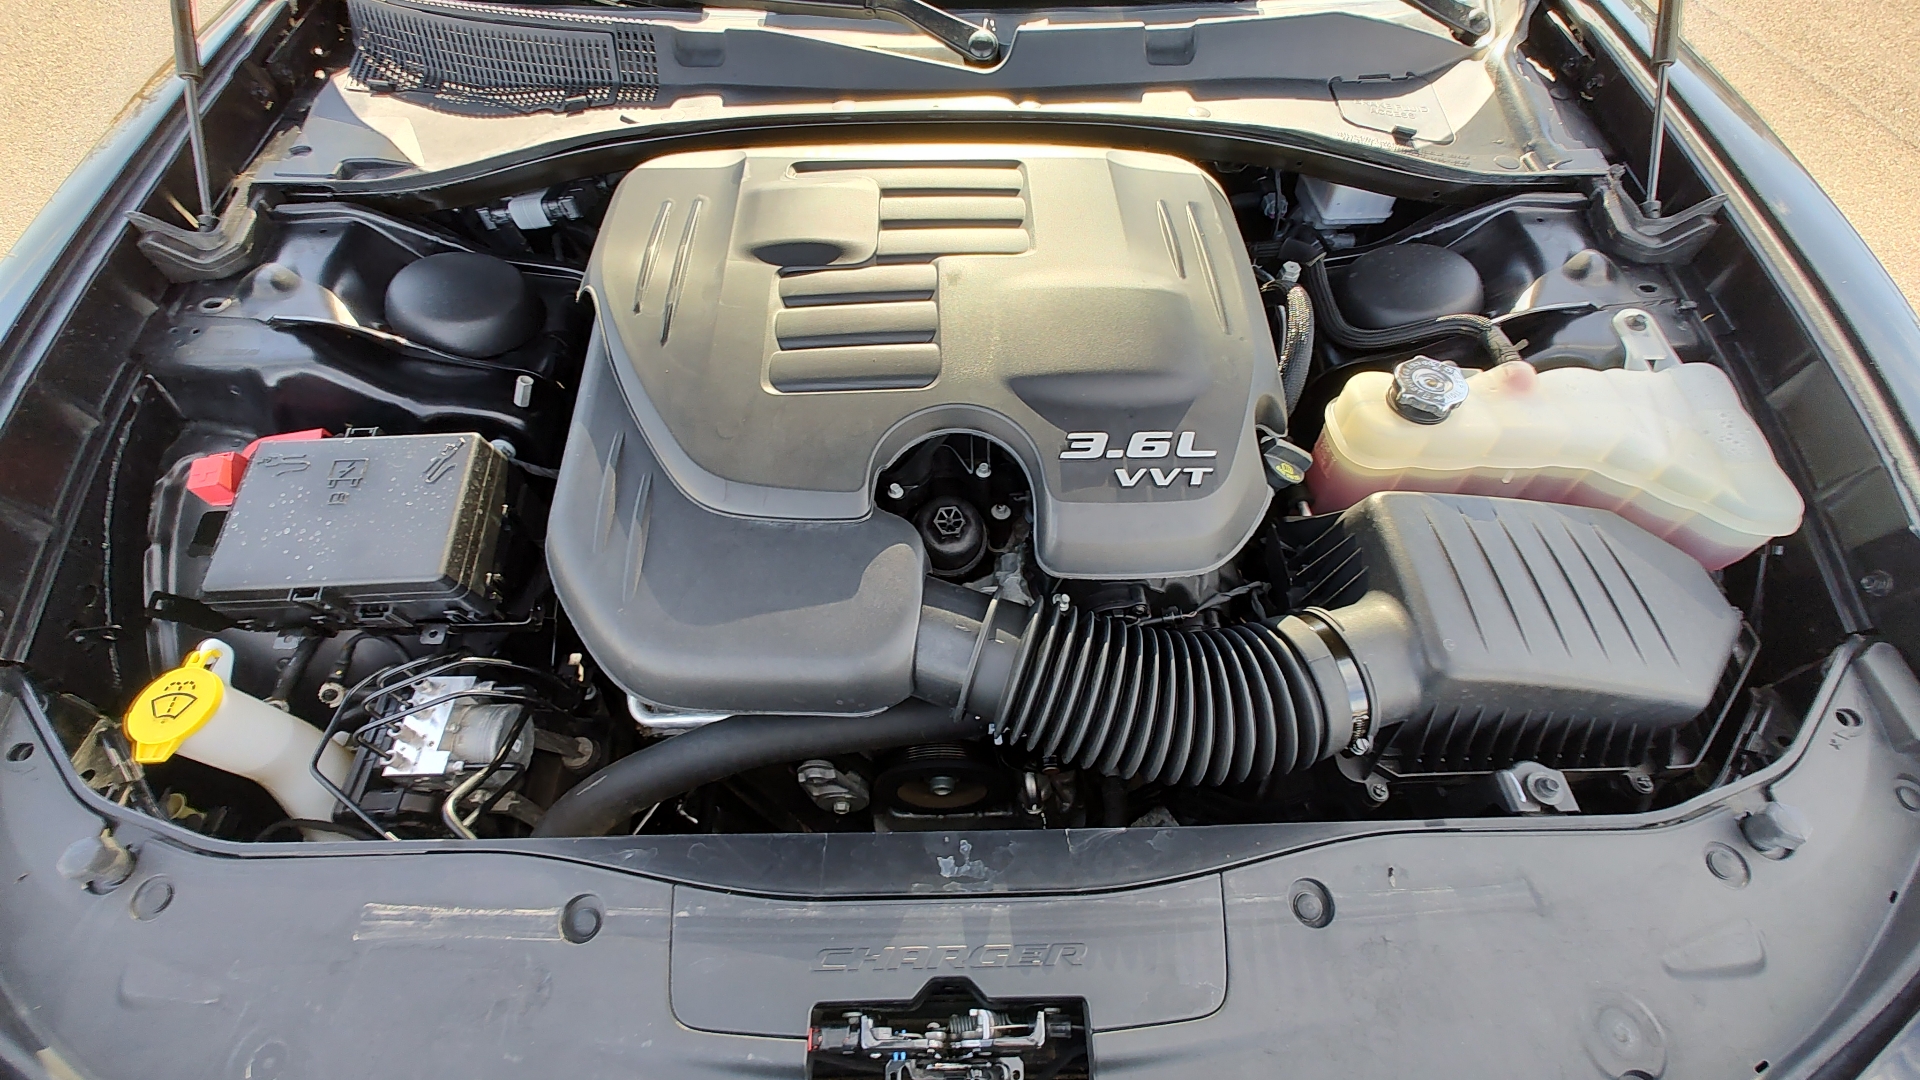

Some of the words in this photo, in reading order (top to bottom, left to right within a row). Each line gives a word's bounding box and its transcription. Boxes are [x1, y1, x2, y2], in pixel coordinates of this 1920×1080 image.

[1059, 431, 1218, 459] 3.6L
[1114, 467, 1214, 488] VVT
[810, 942, 1089, 972] CHARGER
